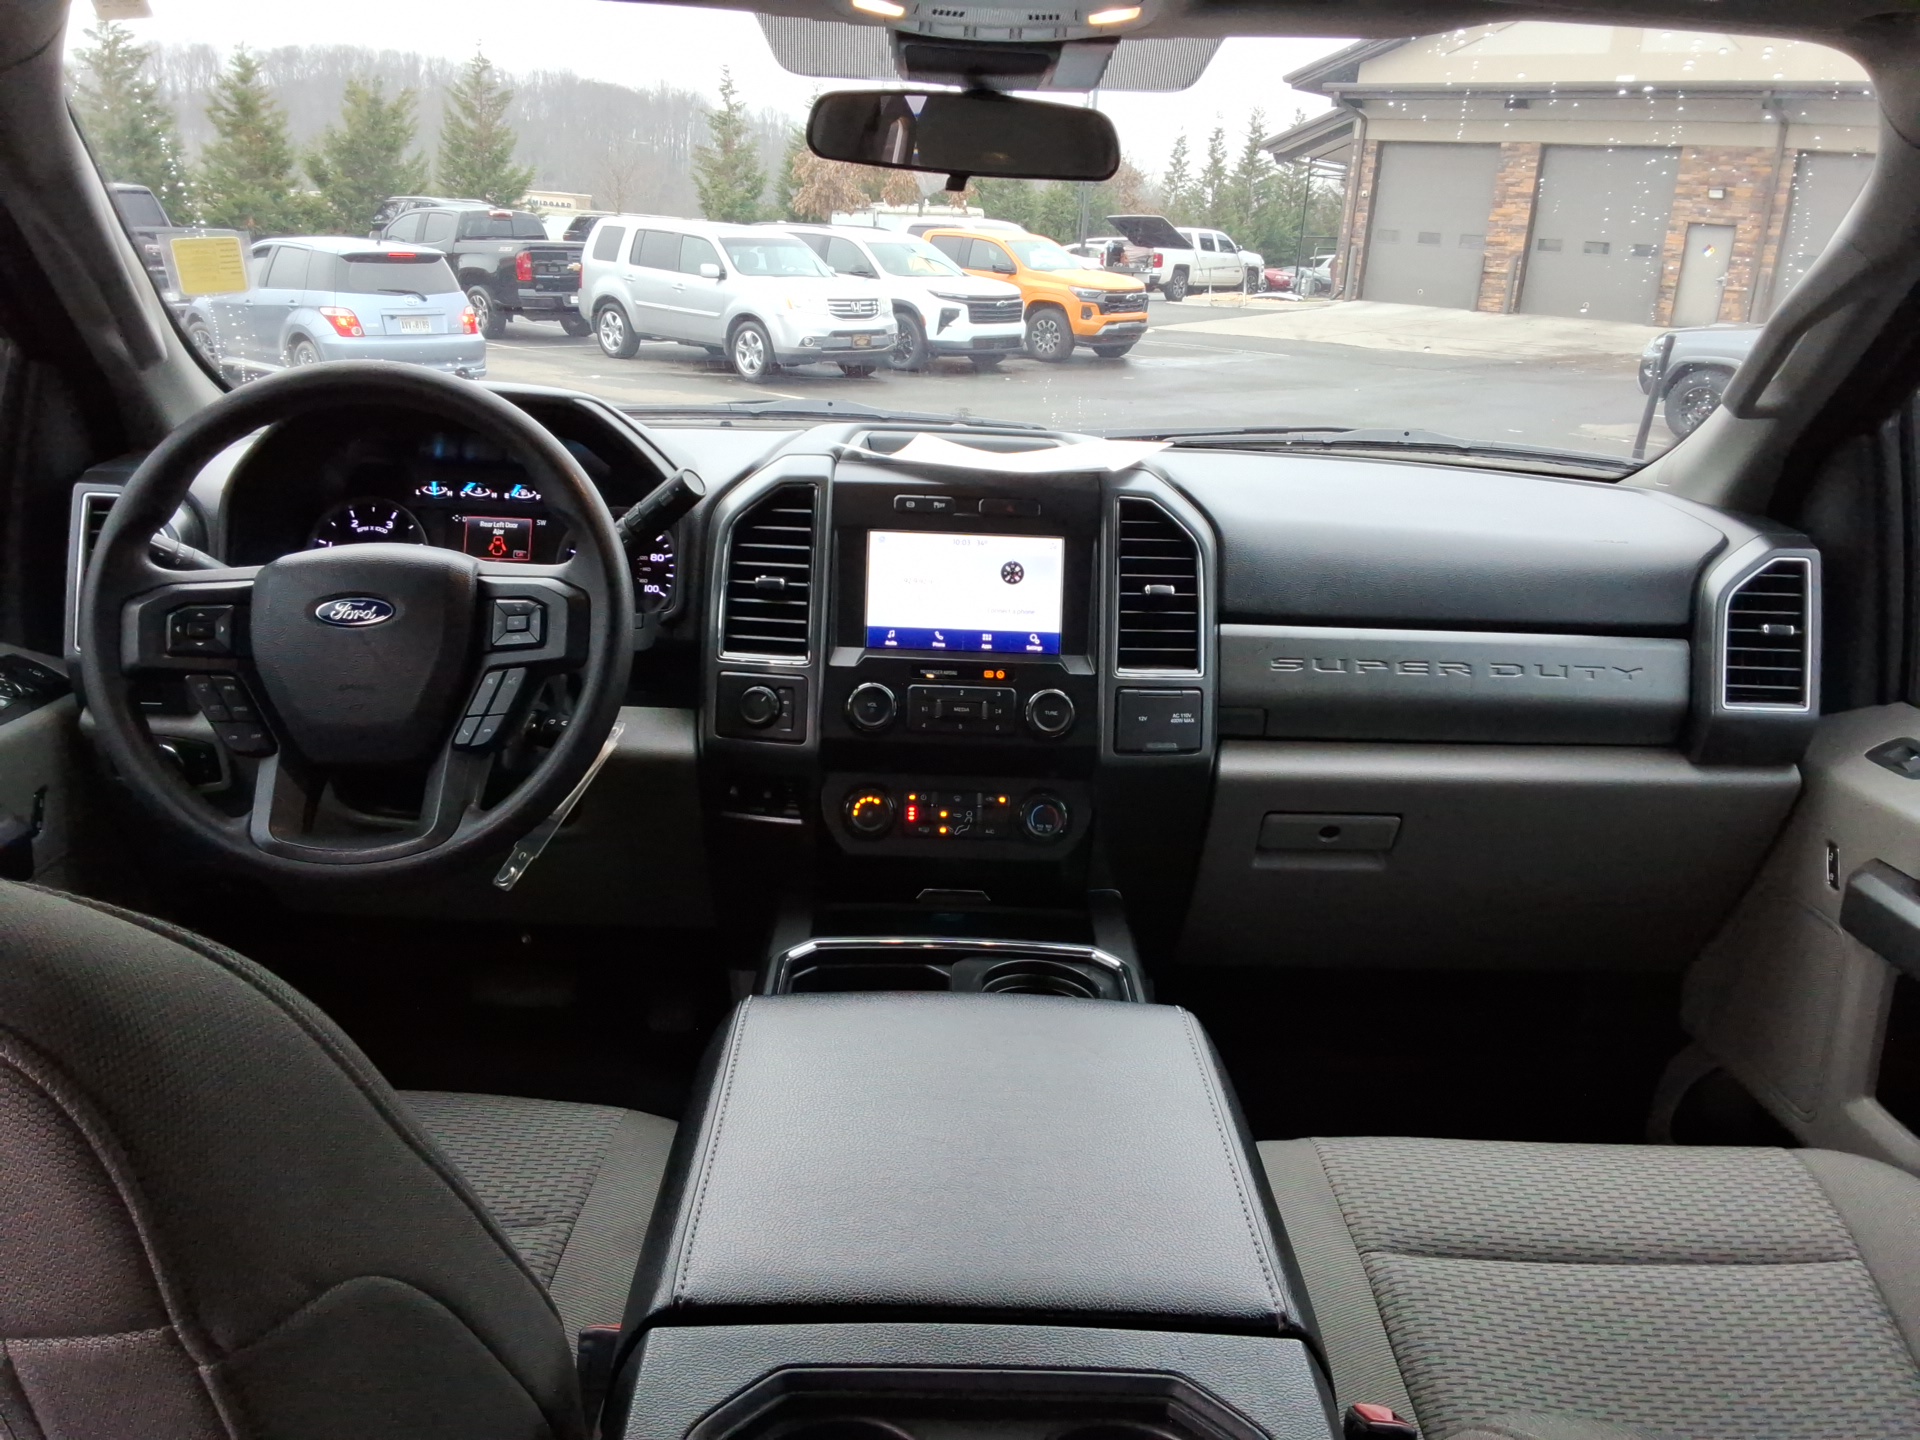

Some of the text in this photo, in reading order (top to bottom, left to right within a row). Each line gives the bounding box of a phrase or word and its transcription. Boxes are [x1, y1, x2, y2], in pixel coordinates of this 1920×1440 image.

[351, 519, 359, 528] 2
[386, 520, 394, 529] 3
[480, 520, 519, 530] Rear Left Door
[649, 553, 665, 562] 80
[644, 584, 660, 593] 100
[330, 601, 377, 621] Ford
[1270, 656, 1643, 681] SUPER DUTY
